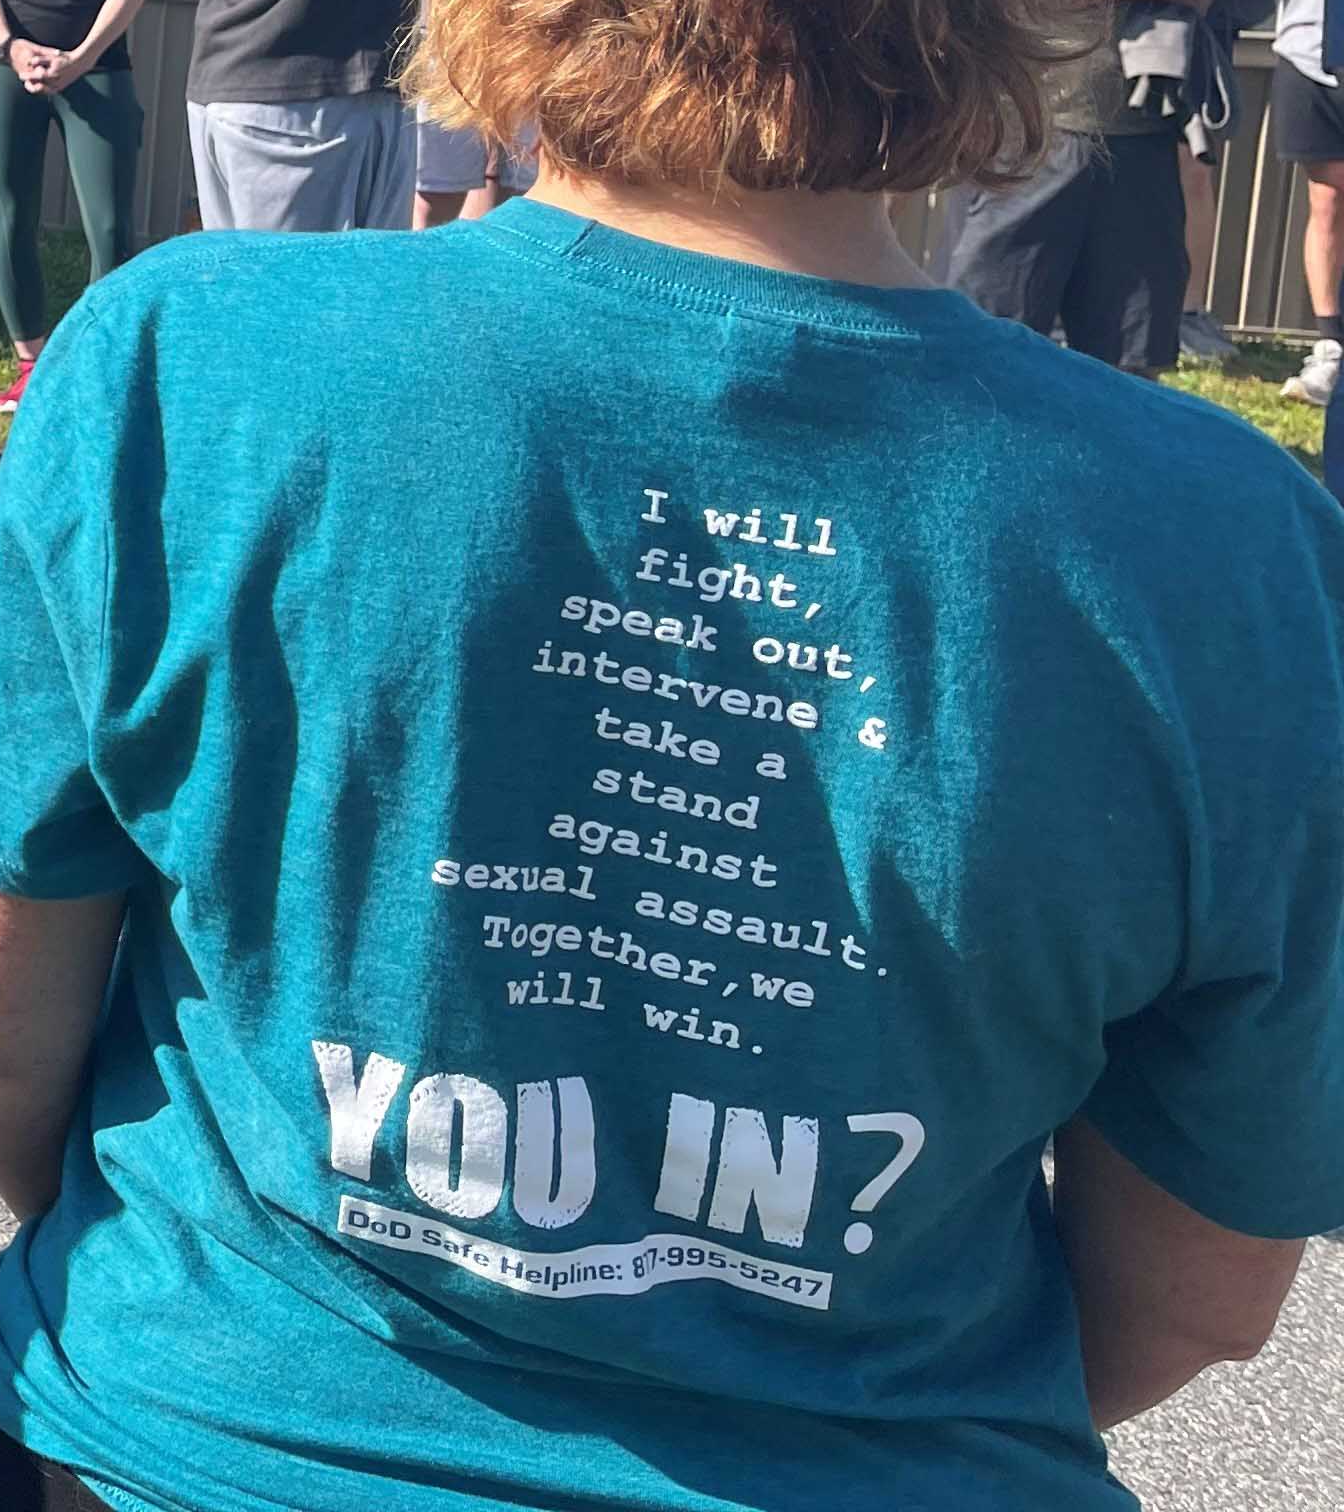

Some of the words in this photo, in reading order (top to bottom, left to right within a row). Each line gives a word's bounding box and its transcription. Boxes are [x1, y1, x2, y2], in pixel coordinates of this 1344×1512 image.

[641, 488, 669, 524] I
[703, 508, 838, 556] will
[635, 547, 824, 621] fight,
[560, 593, 719, 653] speak
[752, 635, 878, 694] out,
[532, 640, 819, 730] intervene
[858, 716, 888, 750] &
[595, 707, 721, 767] take
[756, 750, 787, 780] a
[592, 767, 760, 830] stand
[548, 813, 778, 889] against
[431, 857, 598, 901] sexual
[635, 888, 889, 977] assault.
[506, 970, 607, 1011] will
[642, 1001, 765, 1055] win.
[311, 1039, 597, 1231] YOU
[653, 1090, 927, 1256] IN?
[348, 1210, 411, 1240] DoD
[422, 1228, 491, 1268] Safe
[501, 1255, 623, 1292] Helpline:
